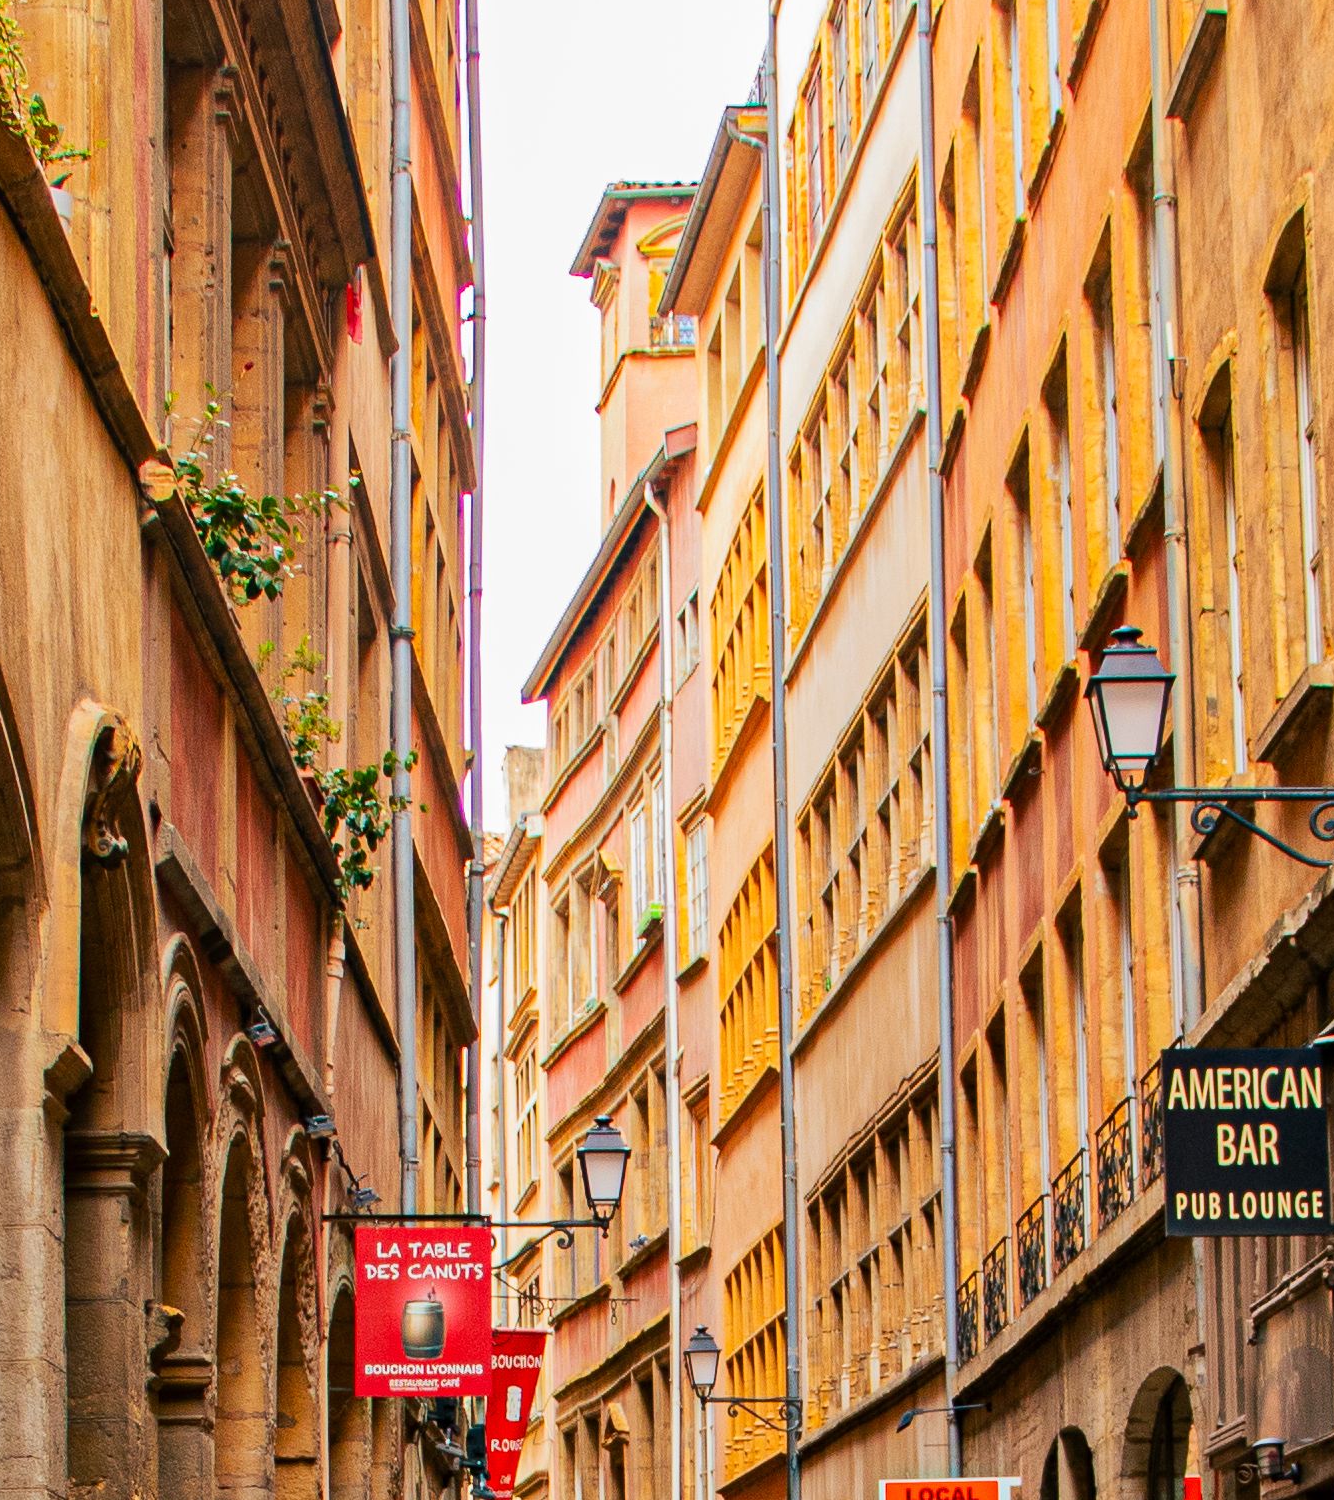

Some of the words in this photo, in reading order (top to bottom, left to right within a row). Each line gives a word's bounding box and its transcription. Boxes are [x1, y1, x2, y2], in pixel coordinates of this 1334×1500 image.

[1168, 1067, 1323, 1110] AMERICAN
[1217, 1124, 1280, 1166] BAR
[1176, 1193, 1221, 1220] PUB
[1229, 1190, 1324, 1220] LOUNGE
[376, 1242, 402, 1259] LA
[408, 1242, 472, 1259] TABLE
[365, 1264, 400, 1280] DES
[407, 1263, 484, 1280] CANUTS
[365, 1364, 424, 1375] BOUCHON
[426, 1364, 483, 1375] LYONNAIS
[491, 1354, 543, 1370] BOUCHON
